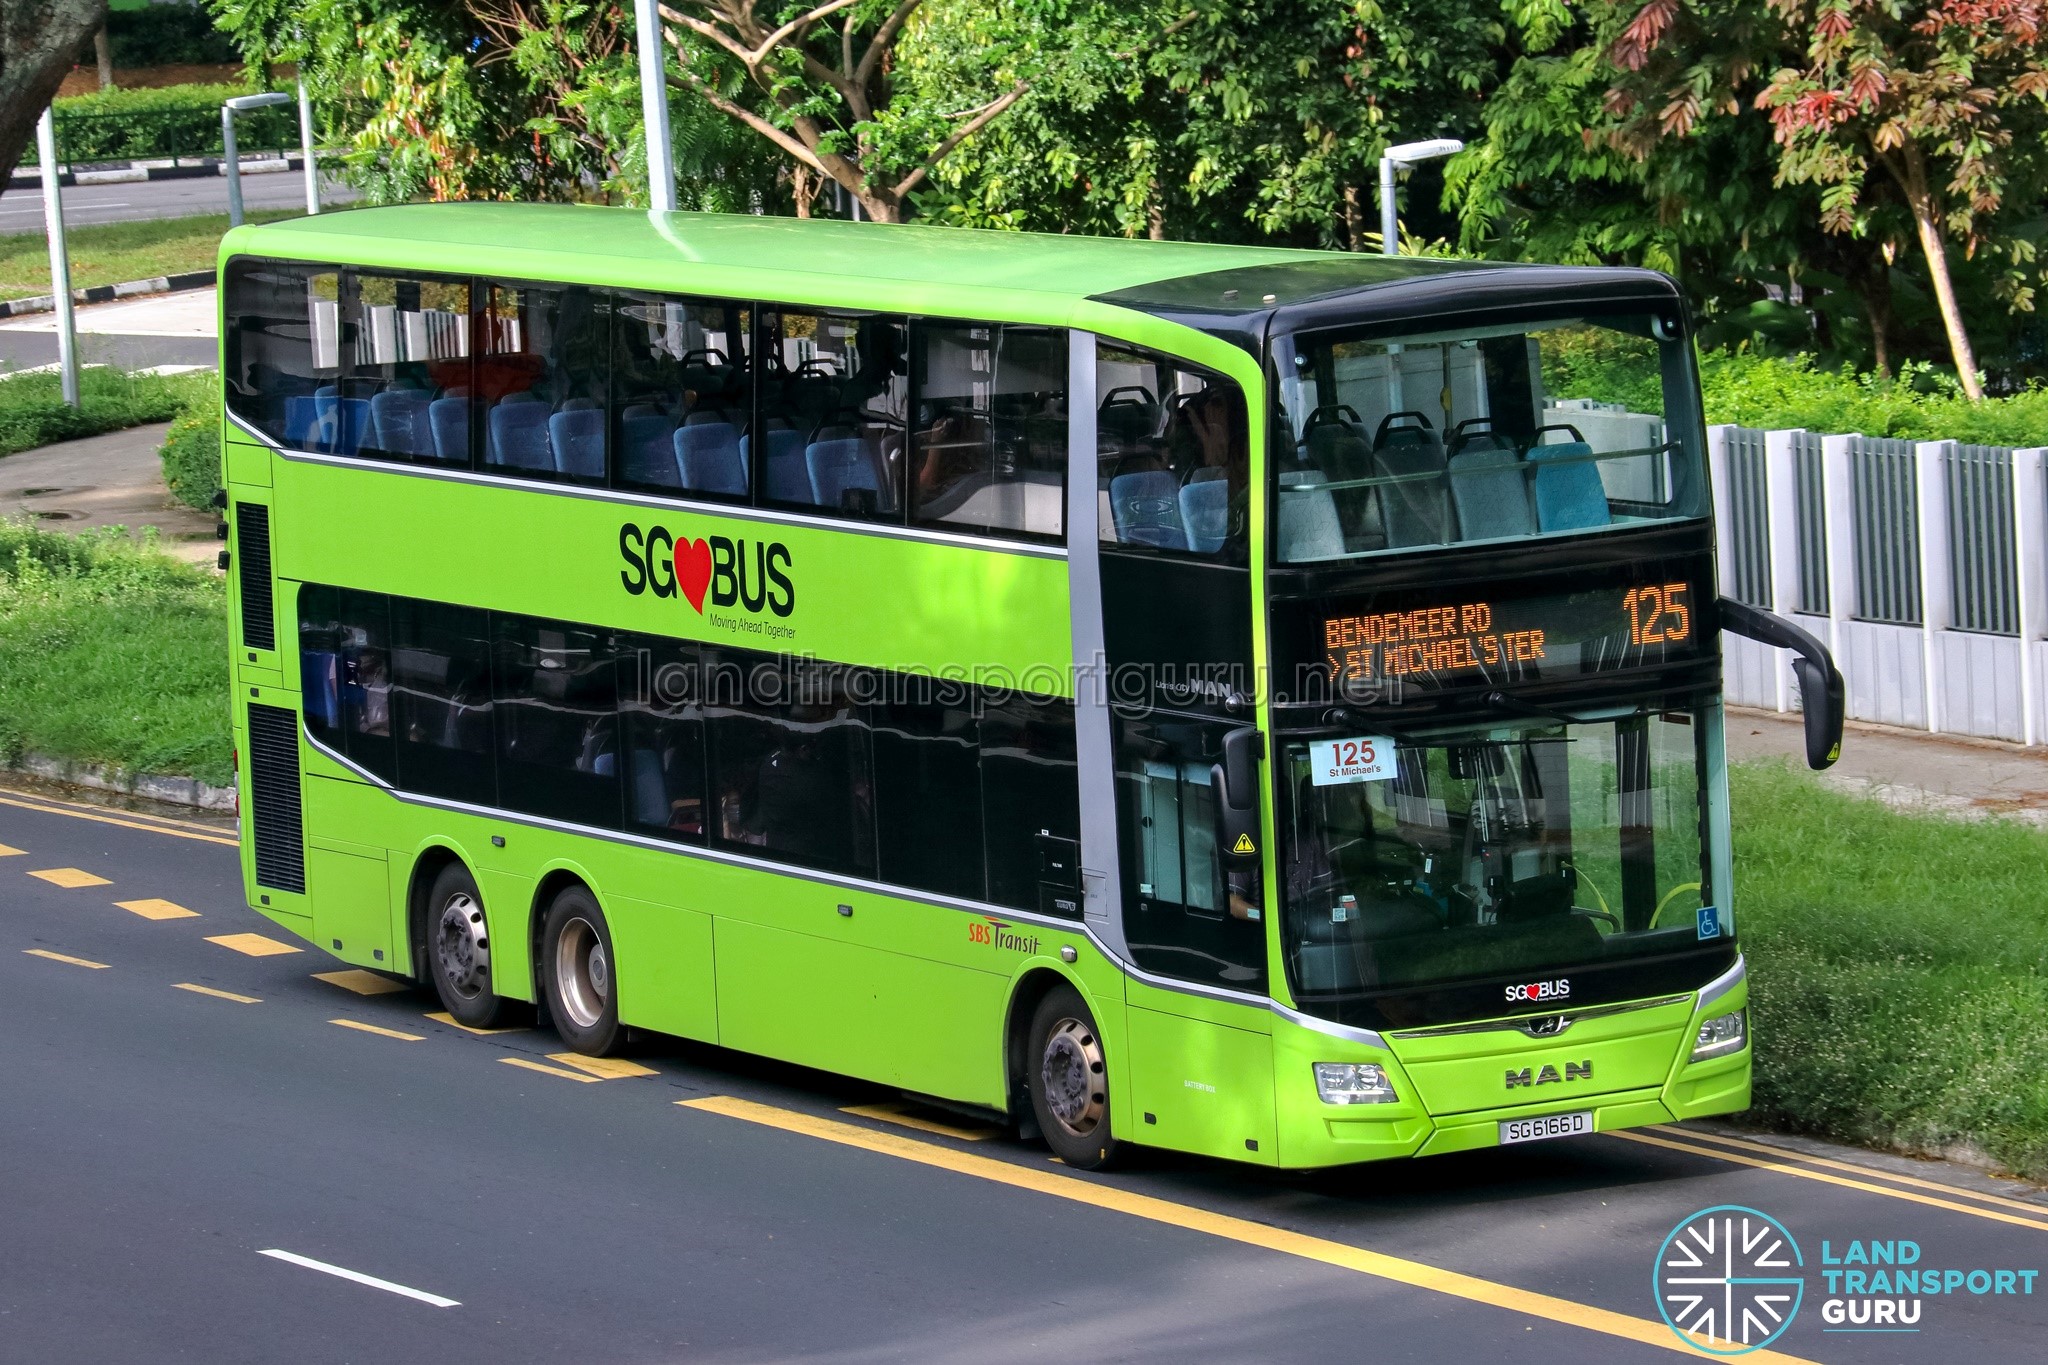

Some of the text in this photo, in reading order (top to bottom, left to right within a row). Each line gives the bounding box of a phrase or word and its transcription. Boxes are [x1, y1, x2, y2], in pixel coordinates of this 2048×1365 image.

[709, 613, 796, 640] Moving Ahead Together
[1326, 603, 1492, 649] BENDEMEER RD
[1623, 583, 1689, 645] 125
[1384, 635, 1499, 676] MICHAEL'S
[1503, 630, 1546, 662] TER
[1175, 682, 1190, 694] City
[1190, 678, 1231, 698] MAN
[1332, 740, 1376, 767] 125
[1329, 764, 1382, 777] St Michael's
[968, 920, 1042, 955] SBS Transit
[1505, 1059, 1593, 1089] MAN
